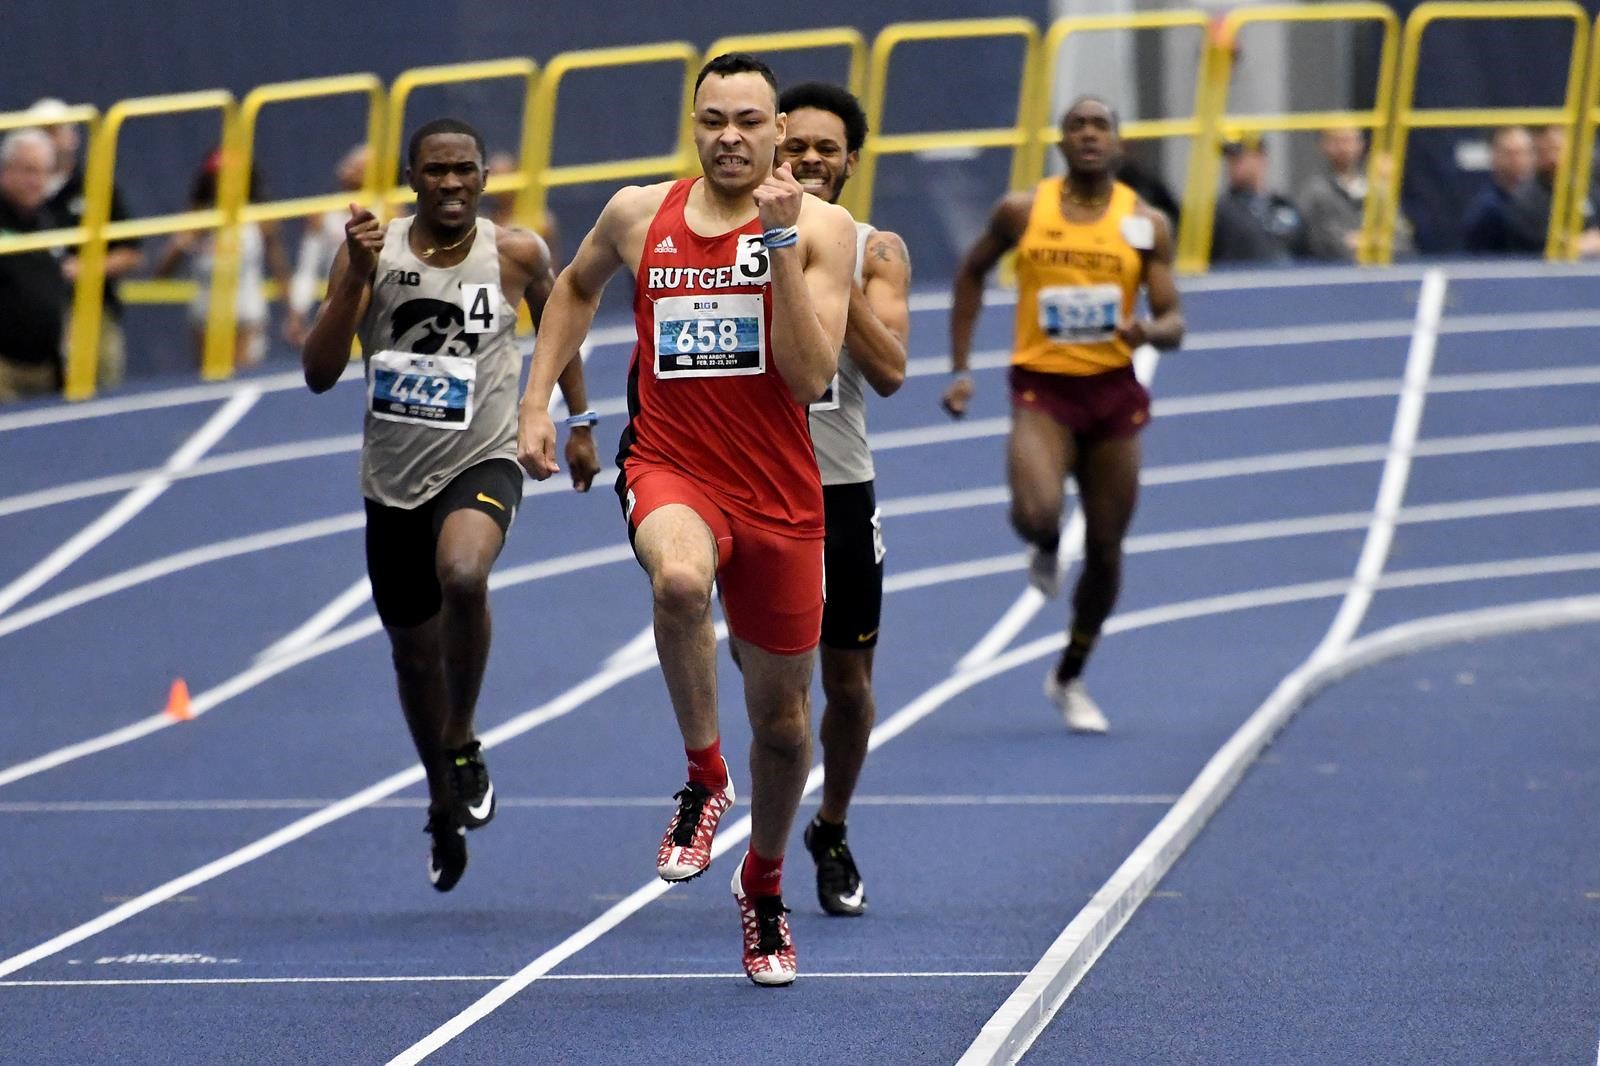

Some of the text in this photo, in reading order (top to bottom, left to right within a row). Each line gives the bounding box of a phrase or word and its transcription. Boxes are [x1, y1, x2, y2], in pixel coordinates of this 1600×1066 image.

[740, 237, 769, 278] 3
[469, 287, 494, 329] 4
[676, 319, 738, 353] 658
[390, 373, 450, 407] 442
